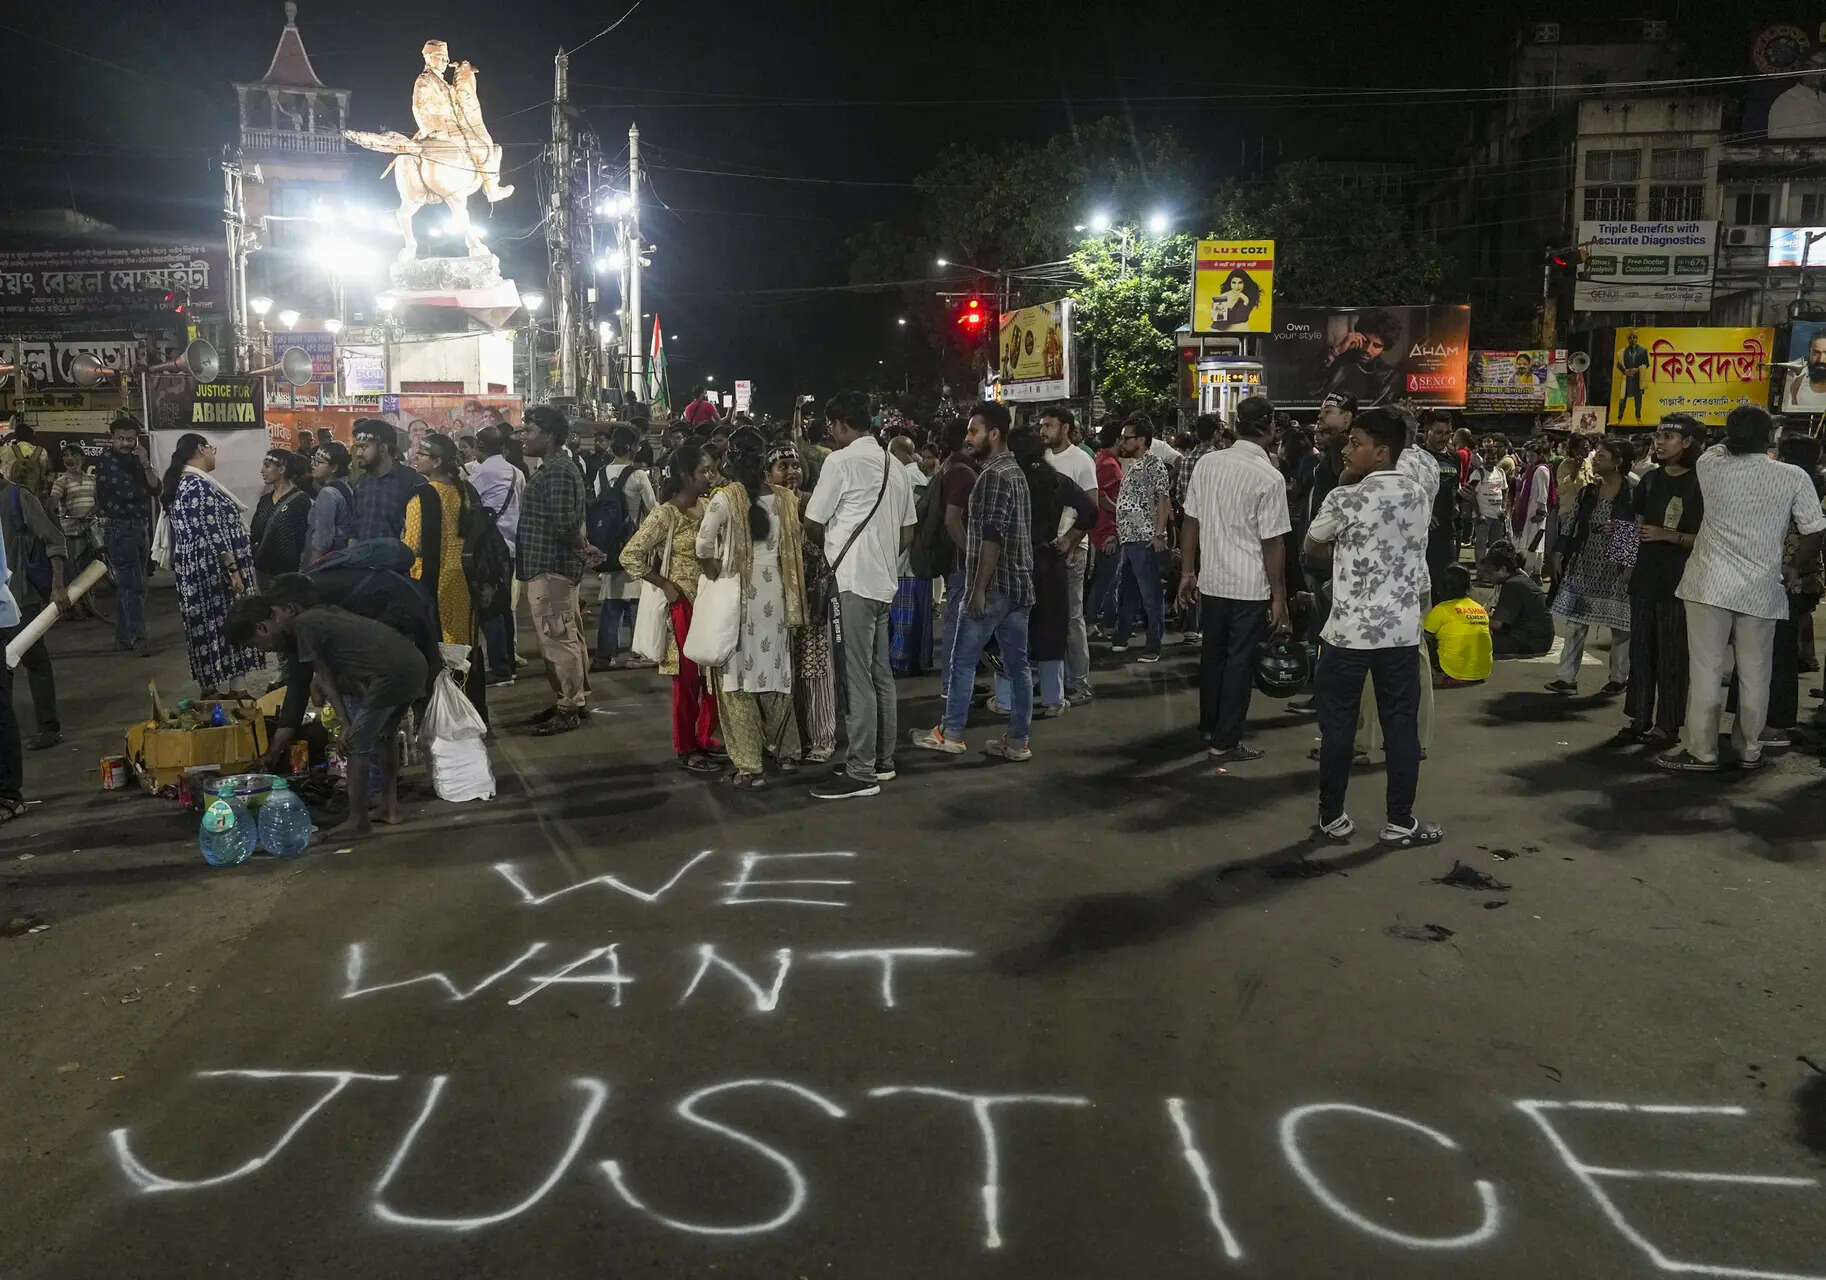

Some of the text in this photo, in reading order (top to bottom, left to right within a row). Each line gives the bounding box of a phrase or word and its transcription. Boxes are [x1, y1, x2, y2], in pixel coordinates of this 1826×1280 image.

[1599, 223, 1700, 235] Triple Benefits with
[1591, 235, 1706, 247] Accurate Diagnostics
[1286, 323, 1311, 332] Own
[1273, 331, 1323, 342] your style
[1649, 338, 1767, 385] কিংবদন্তী
[1419, 375, 1457, 386] SENCO
[196, 384, 251, 398] JUSTICE FOR
[191, 402, 256, 423] ABHAYA
[493, 849, 857, 907] WE
[339, 941, 975, 1013] WANT
[107, 1067, 1826, 1280] JUSTICE
